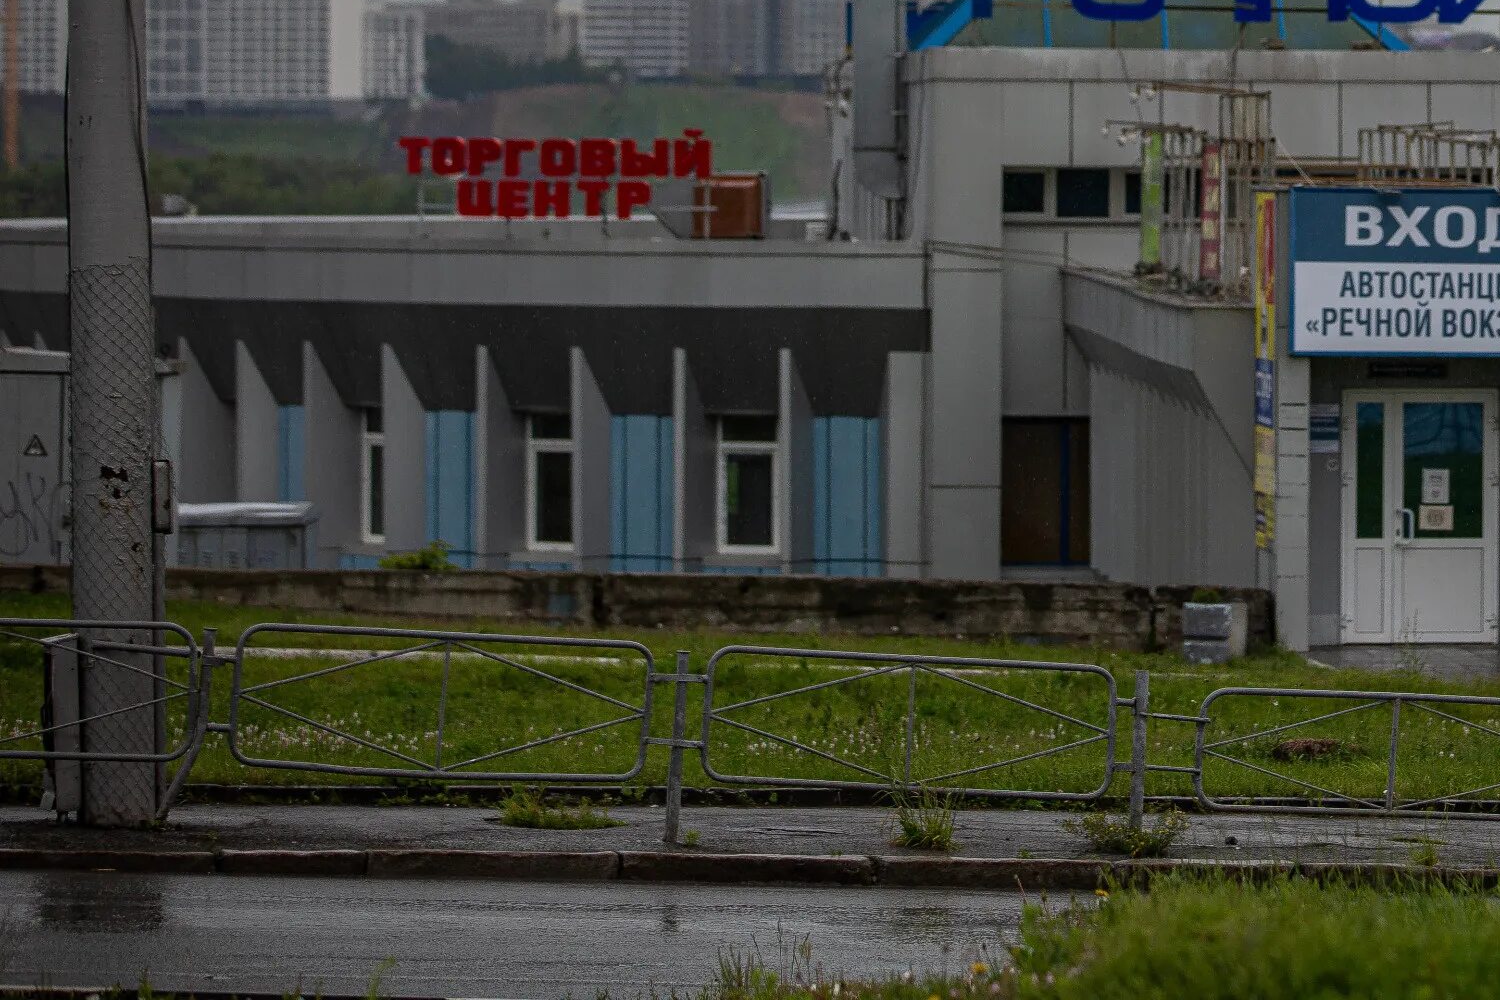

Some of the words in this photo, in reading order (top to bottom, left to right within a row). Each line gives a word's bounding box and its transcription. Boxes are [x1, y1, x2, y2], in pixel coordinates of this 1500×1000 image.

[398, 129, 712, 178] ТОРГОВЫЙ
[456, 179, 652, 219] ЦЕНТР
[1305, 303, 1431, 338] «РЕЧНОЙ
